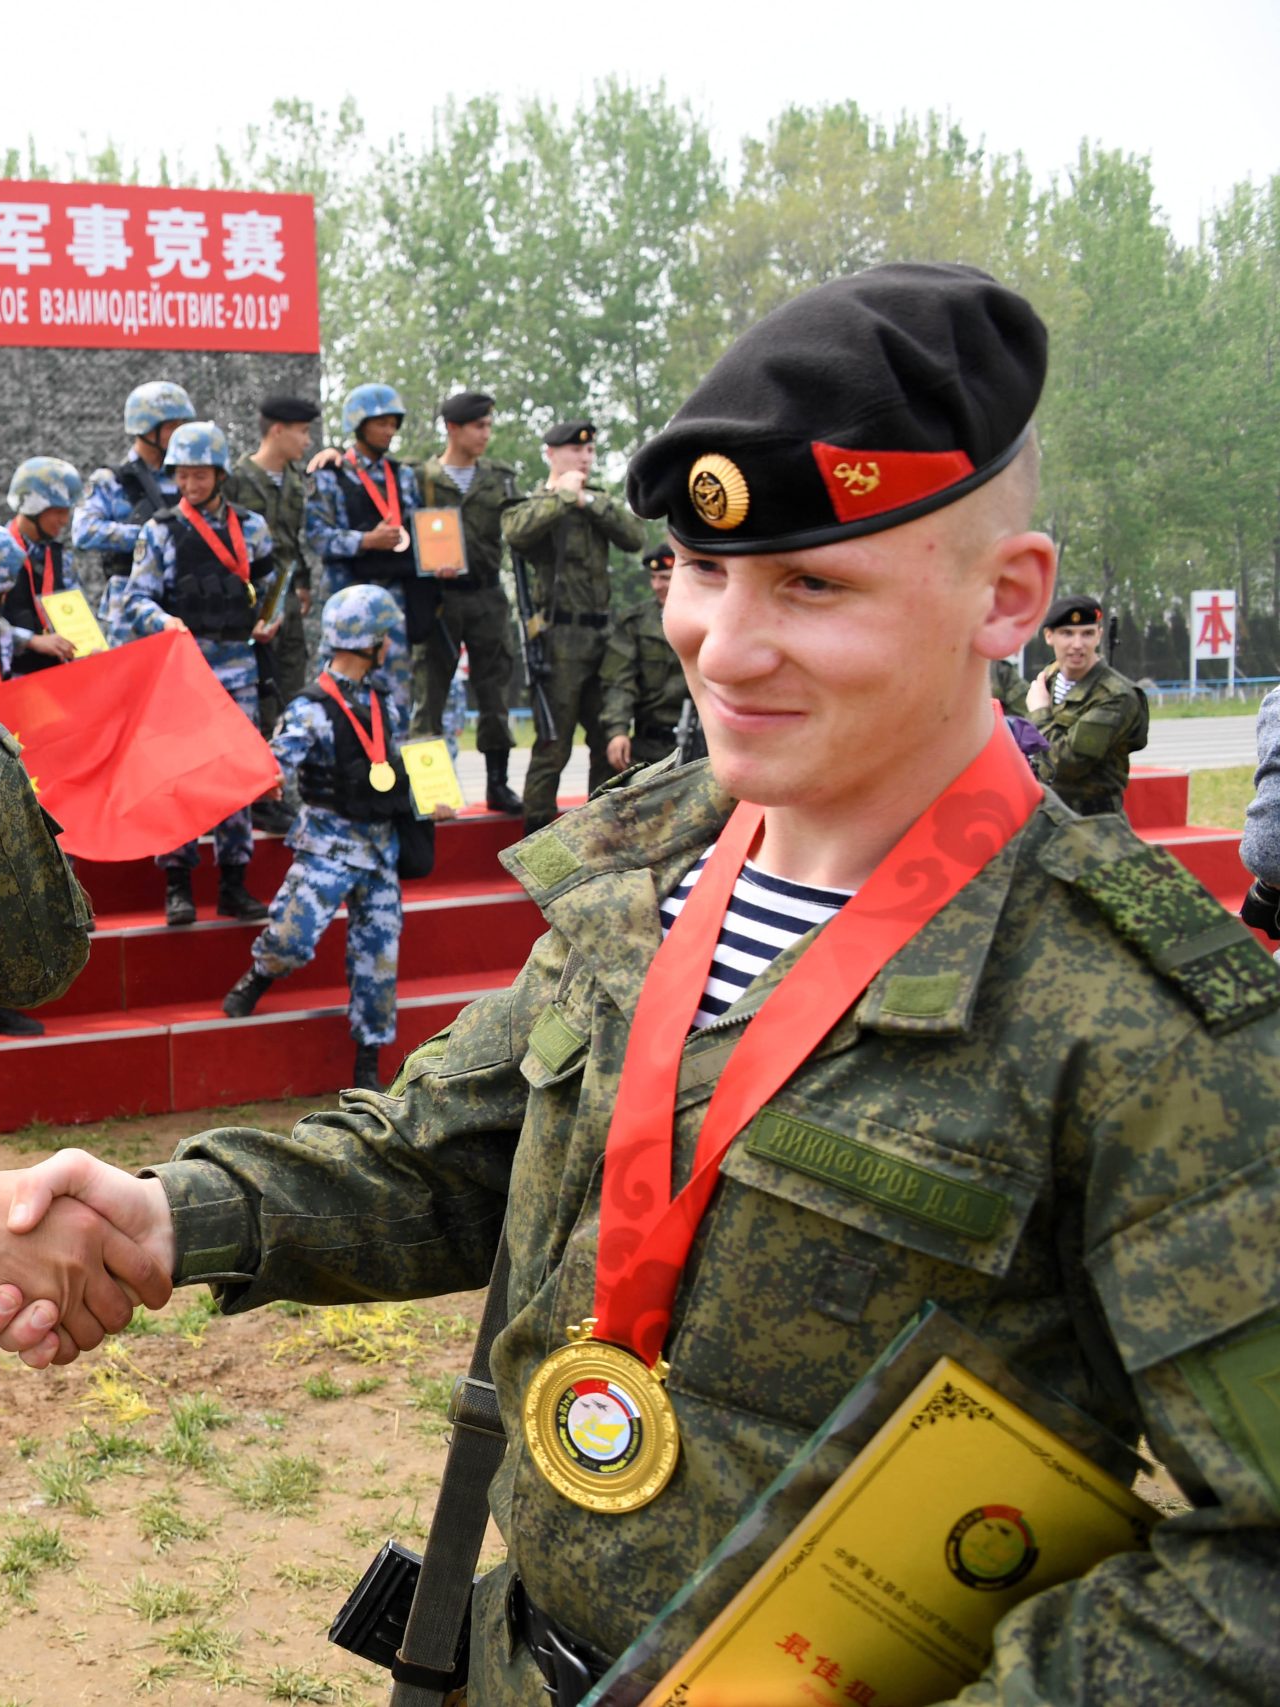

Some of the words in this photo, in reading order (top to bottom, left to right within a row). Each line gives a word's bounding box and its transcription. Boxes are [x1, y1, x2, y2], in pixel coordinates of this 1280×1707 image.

[39, 282, 290, 335] ВЗАИМОДЕЙСТВИЕ-2019"
[1196, 596, 1234, 655] 本
[768, 1121, 920, 1200] НИКИФОРОВ
